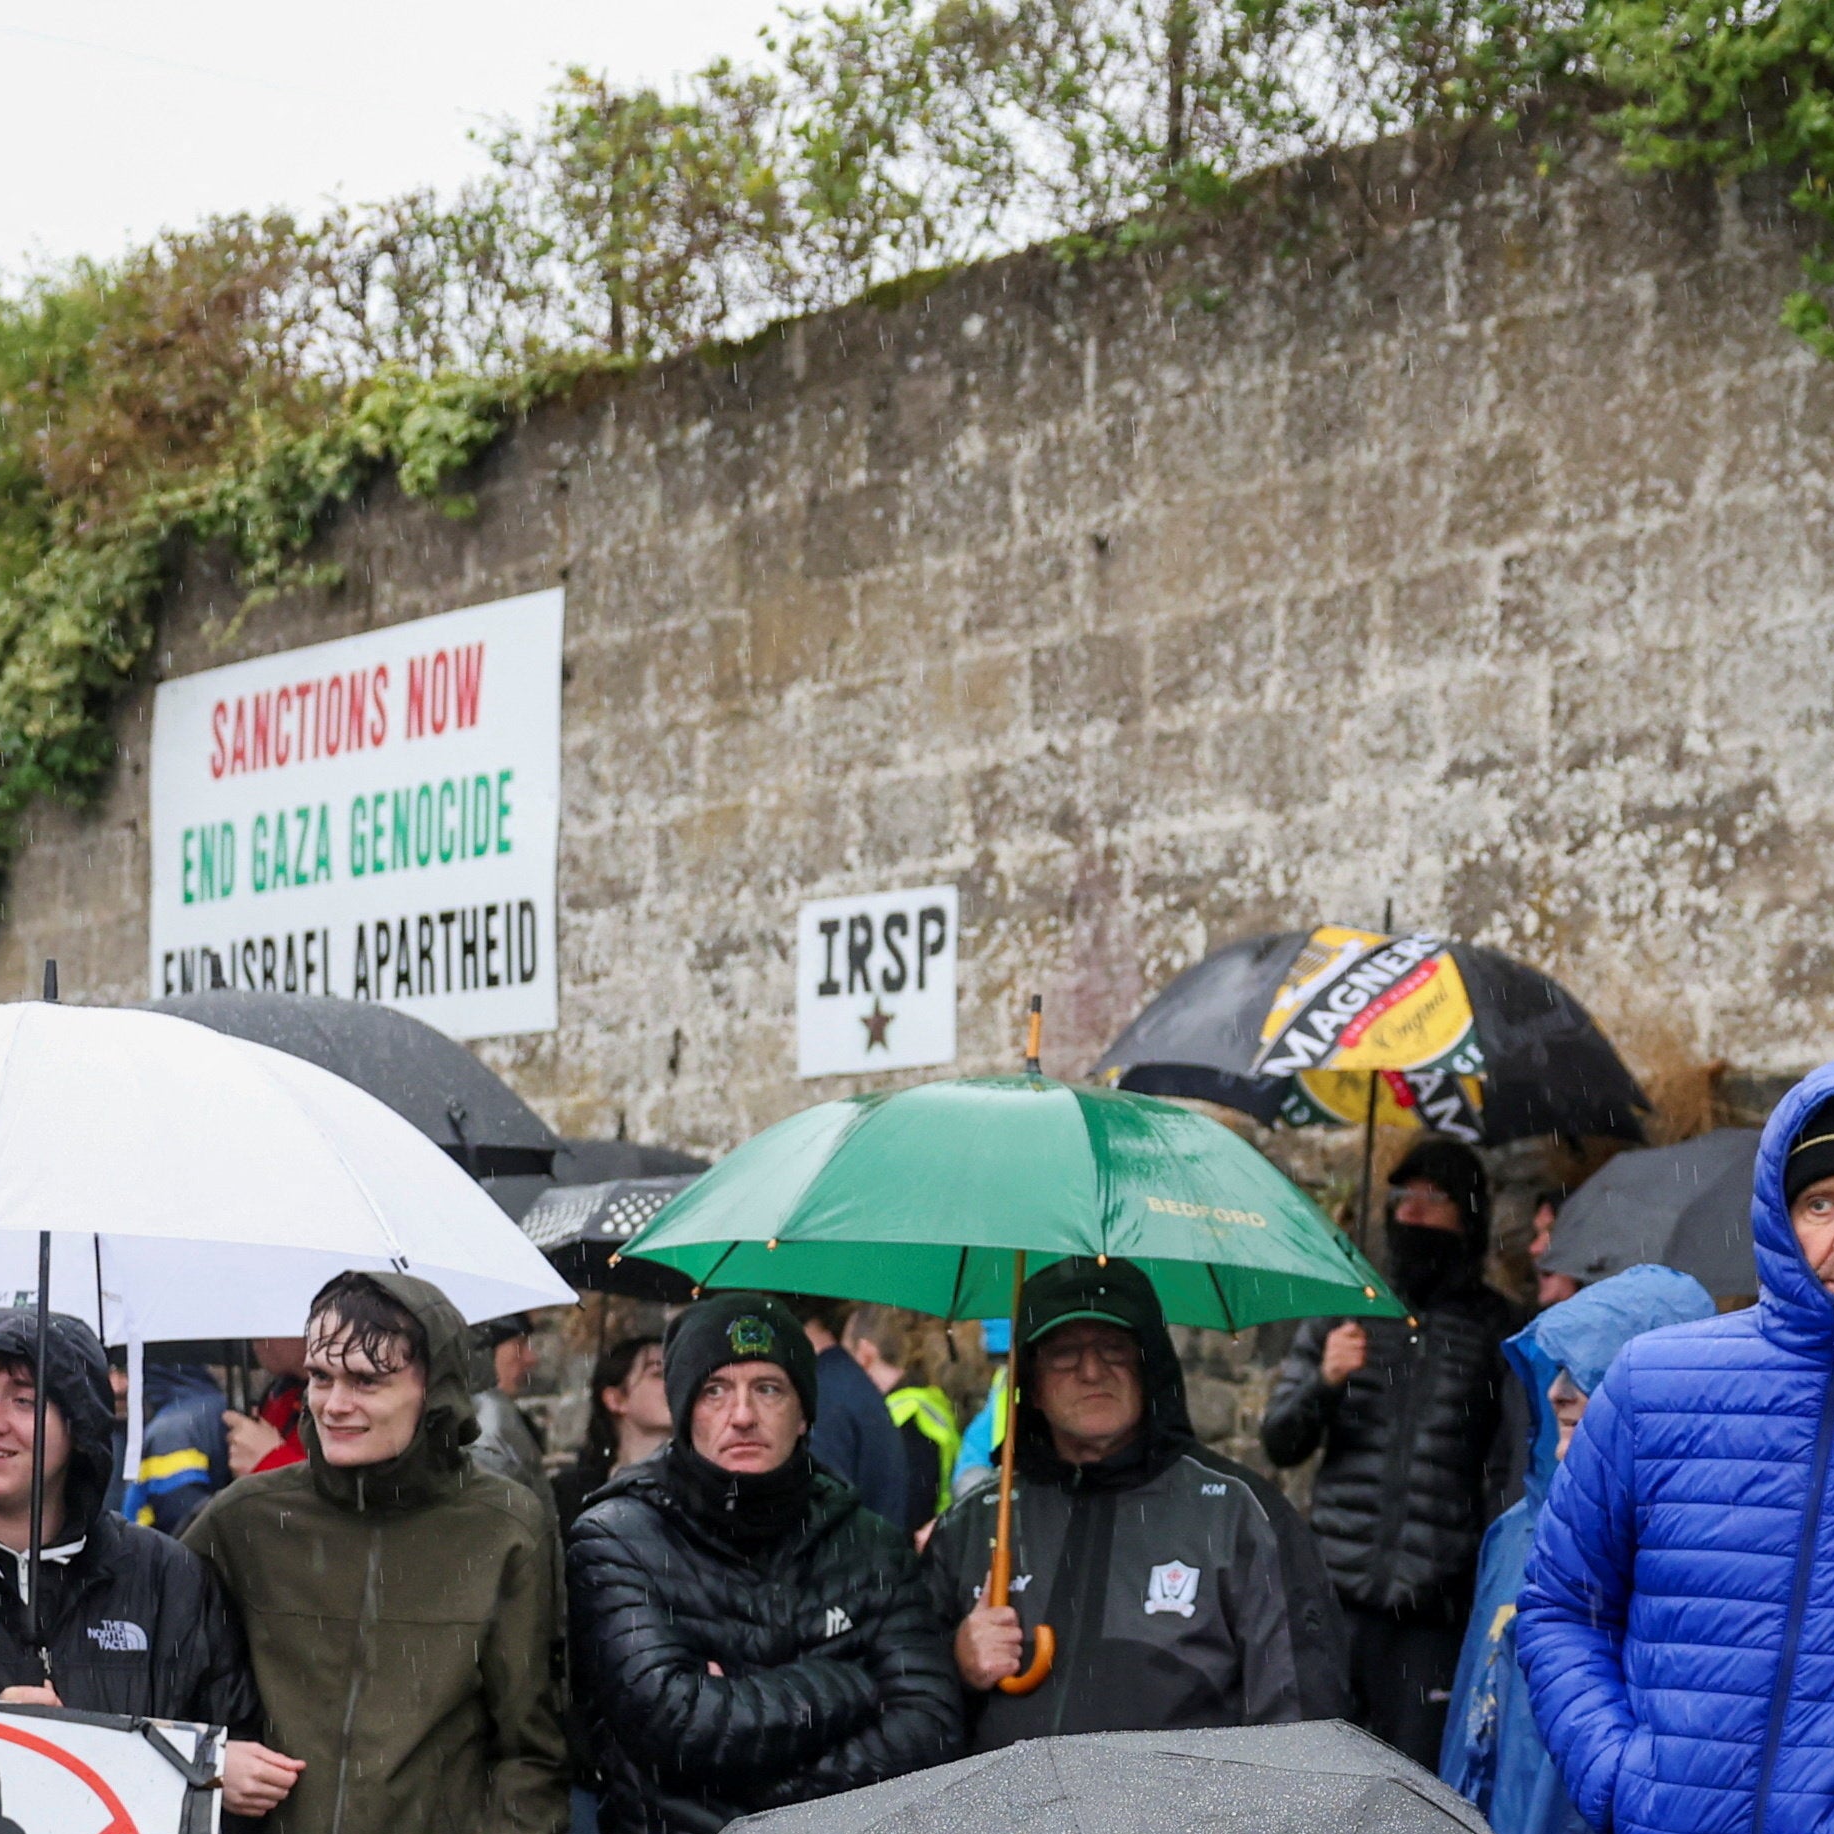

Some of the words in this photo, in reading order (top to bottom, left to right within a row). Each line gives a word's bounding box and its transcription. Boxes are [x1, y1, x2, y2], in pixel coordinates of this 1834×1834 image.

[210, 662, 391, 781] SANCTIONS
[405, 641, 486, 741] NOW
[181, 821, 237, 905] END
[251, 802, 332, 893] GAZA
[349, 767, 515, 879] GENOCIDE
[230, 927, 332, 998] ISRAEL
[353, 899, 539, 1001] APARTHEID
[816, 906, 948, 997] IRSP
[1261, 931, 1444, 1078] MAGNERS
[1200, 1483, 1228, 1497] KM
[87, 1626, 126, 1641] NORTH
[98, 1640, 128, 1651] FACE
[101, 1619, 126, 1631] THE
